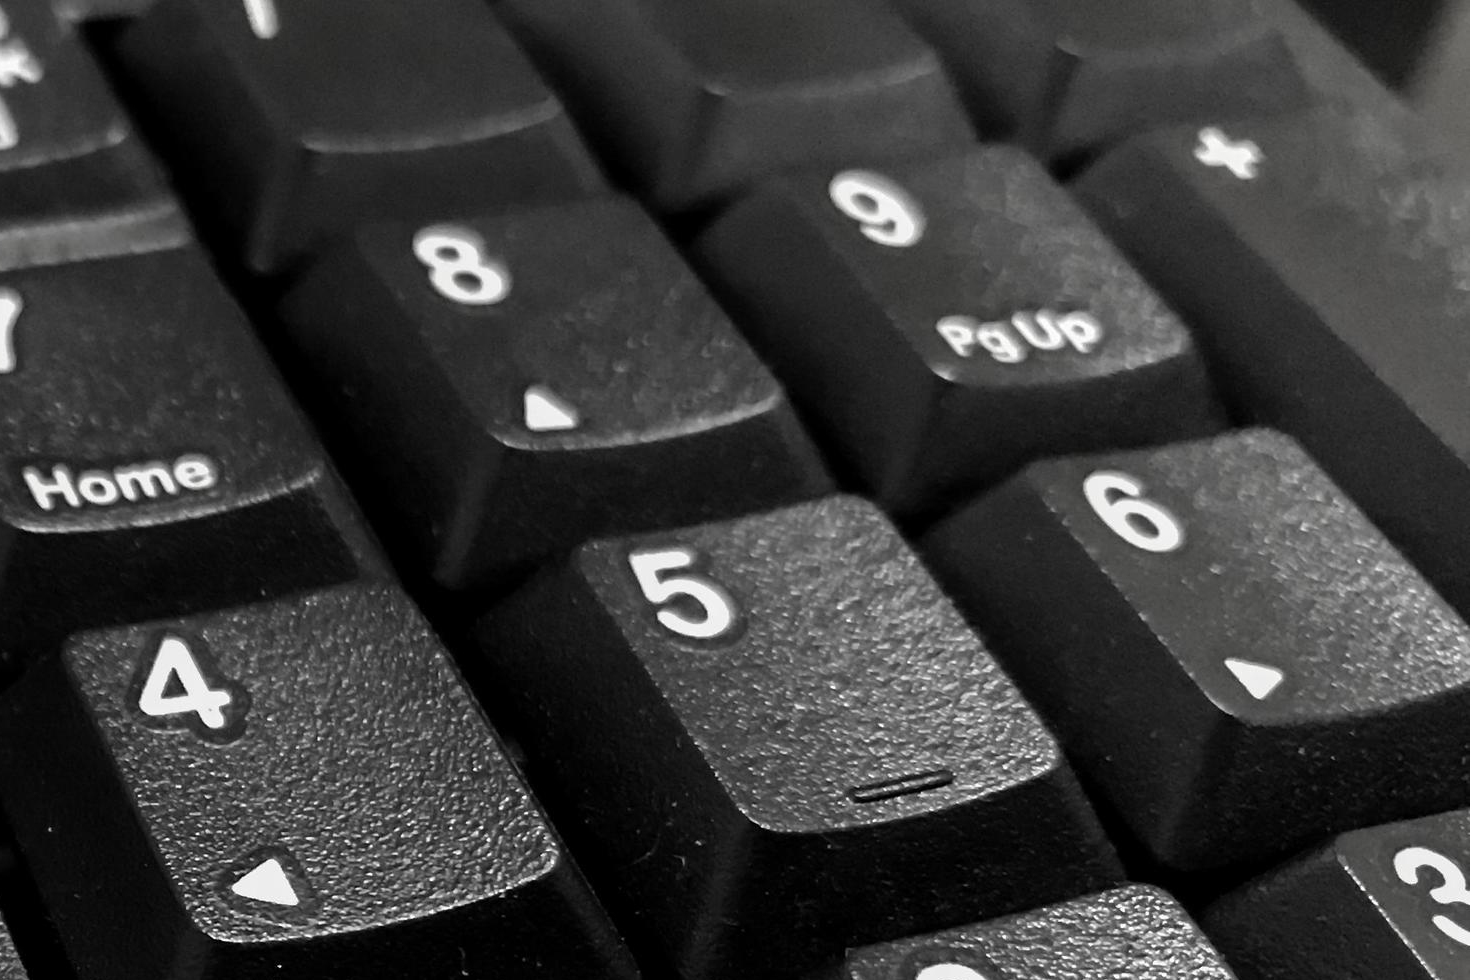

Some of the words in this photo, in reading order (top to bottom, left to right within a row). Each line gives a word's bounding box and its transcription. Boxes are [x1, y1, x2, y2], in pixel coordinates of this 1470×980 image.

[830, 168, 926, 247] 9
[412, 223, 512, 305] 8
[23, 453, 219, 511] Home
[1083, 470, 1186, 552] 6
[629, 550, 732, 639] 5
[139, 638, 230, 729] 4
[1393, 847, 1470, 946] 3
